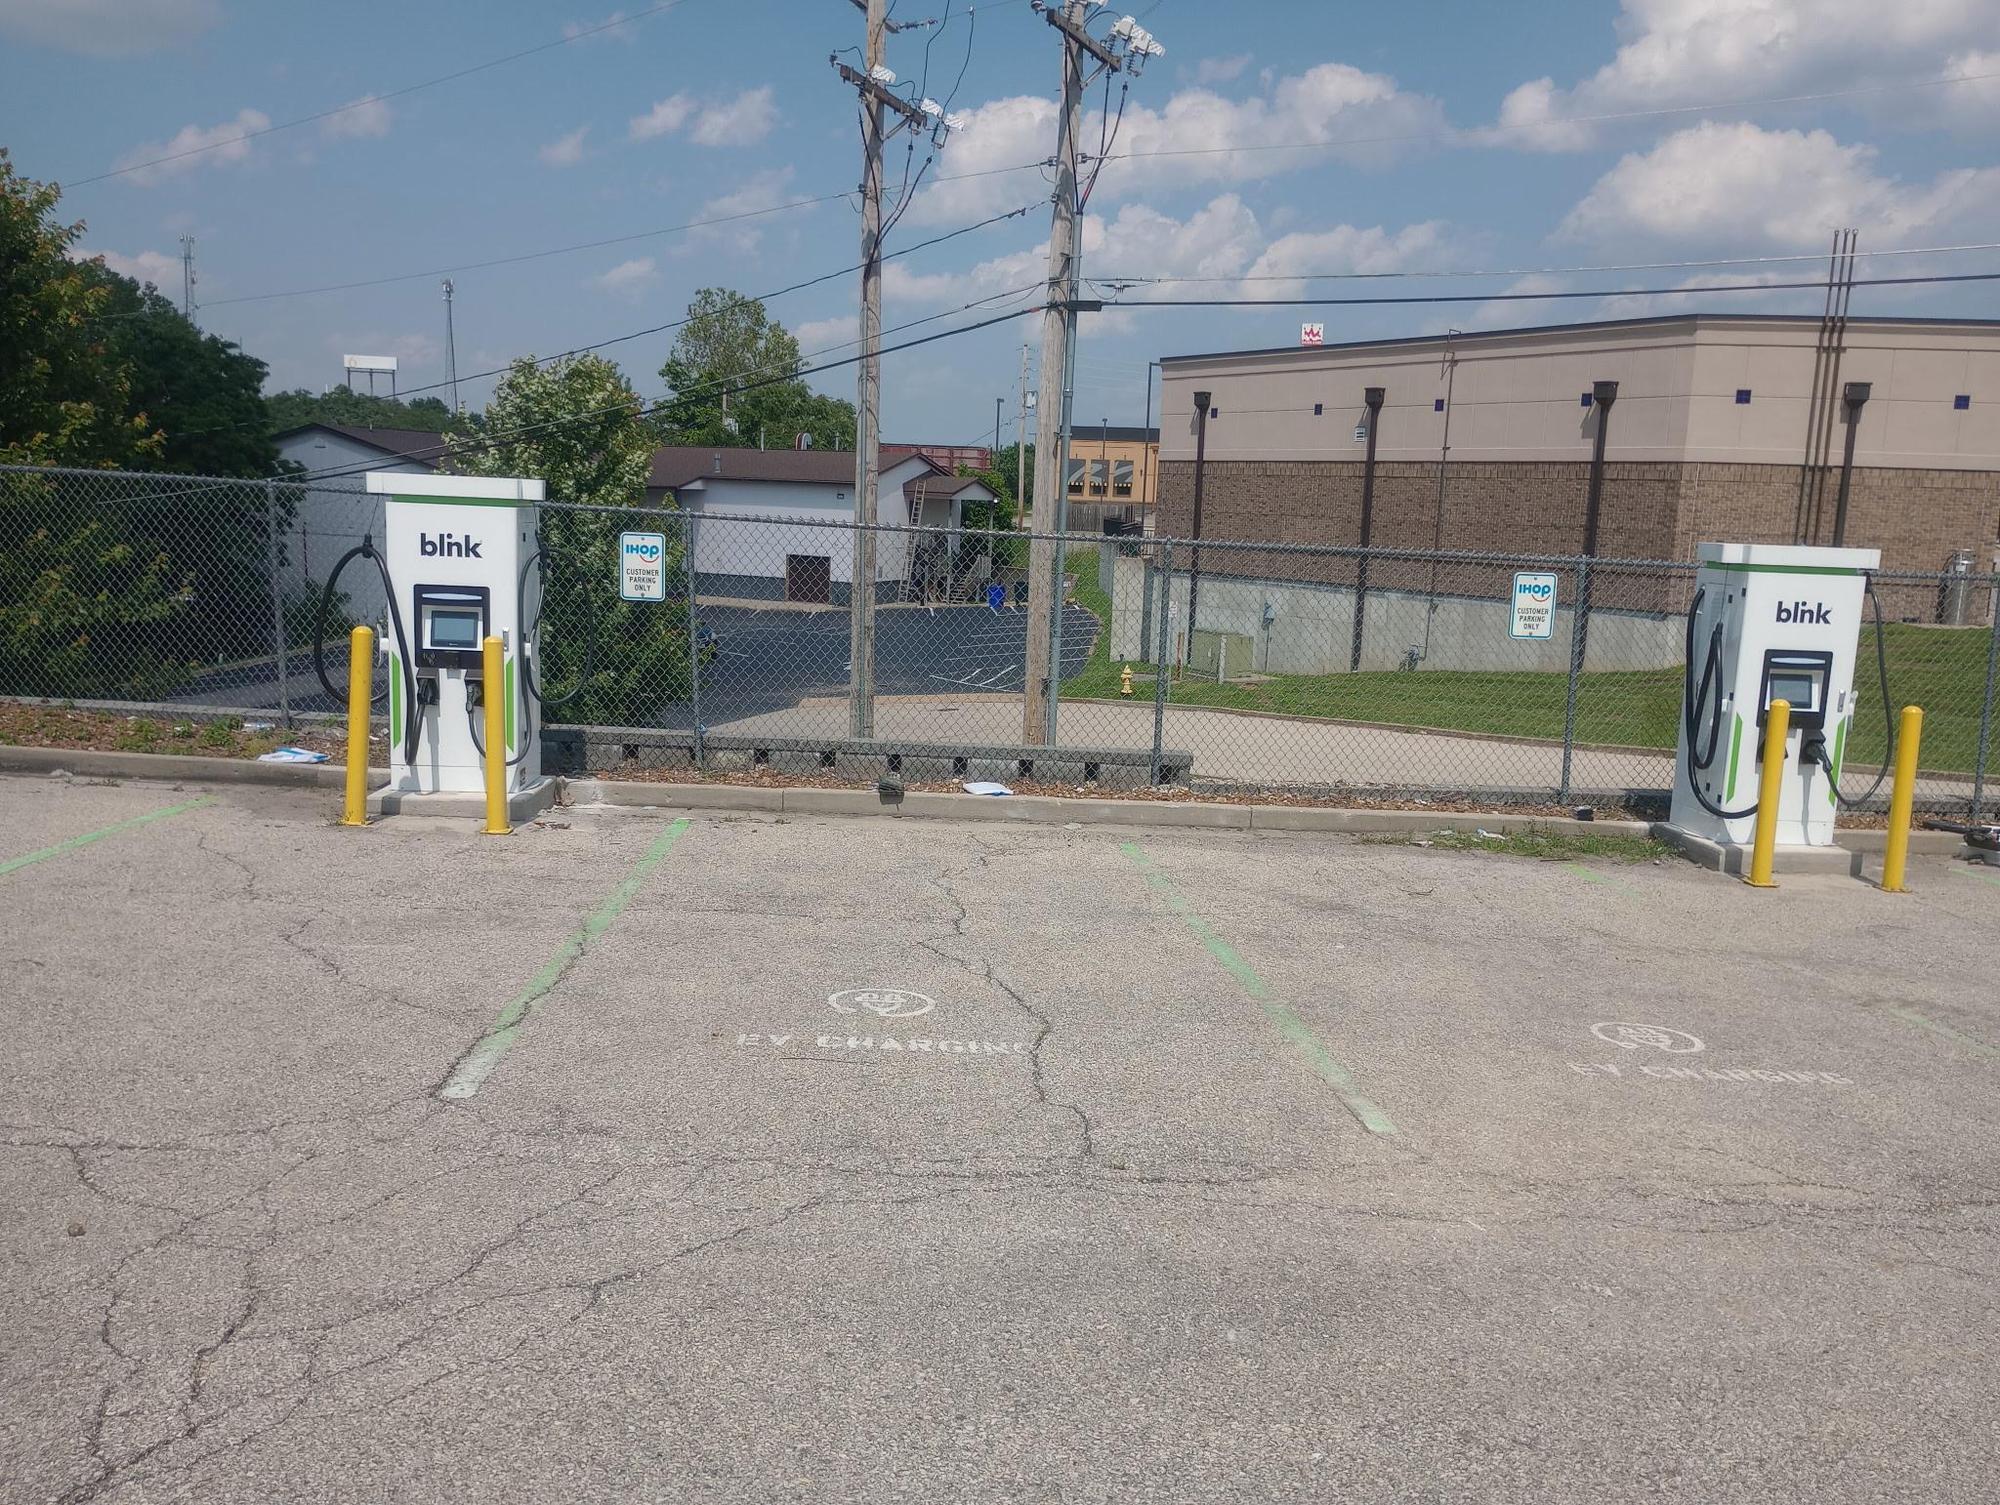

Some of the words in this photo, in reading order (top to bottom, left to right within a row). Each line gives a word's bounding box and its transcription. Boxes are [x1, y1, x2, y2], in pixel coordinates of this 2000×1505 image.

[420, 532, 483, 559] blink
[626, 568, 659, 576] CUSTOMER
[629, 576, 656, 584] PARKING
[634, 584, 651, 592] ONLY
[1775, 600, 1832, 625] blink
